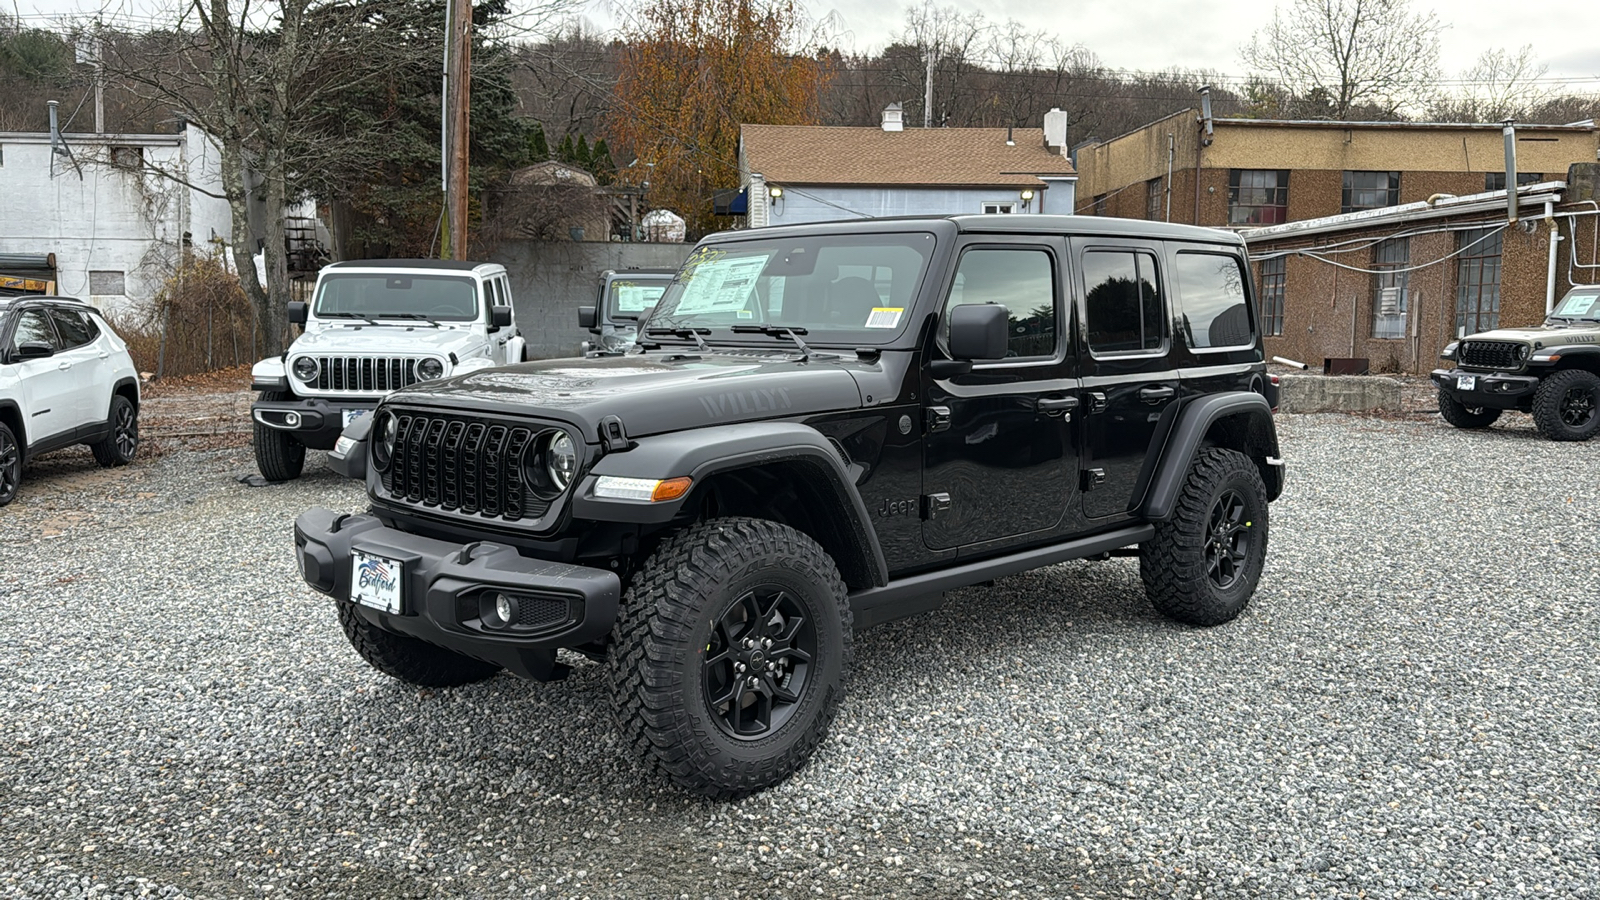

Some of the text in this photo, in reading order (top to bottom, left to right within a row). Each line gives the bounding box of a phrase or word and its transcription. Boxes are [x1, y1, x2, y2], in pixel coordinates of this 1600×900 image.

[1564, 335, 1596, 344] WILLYS
[698, 387, 792, 418] WILLYS
[878, 498, 915, 518] Jeep
[359, 563, 396, 595] Bedford
